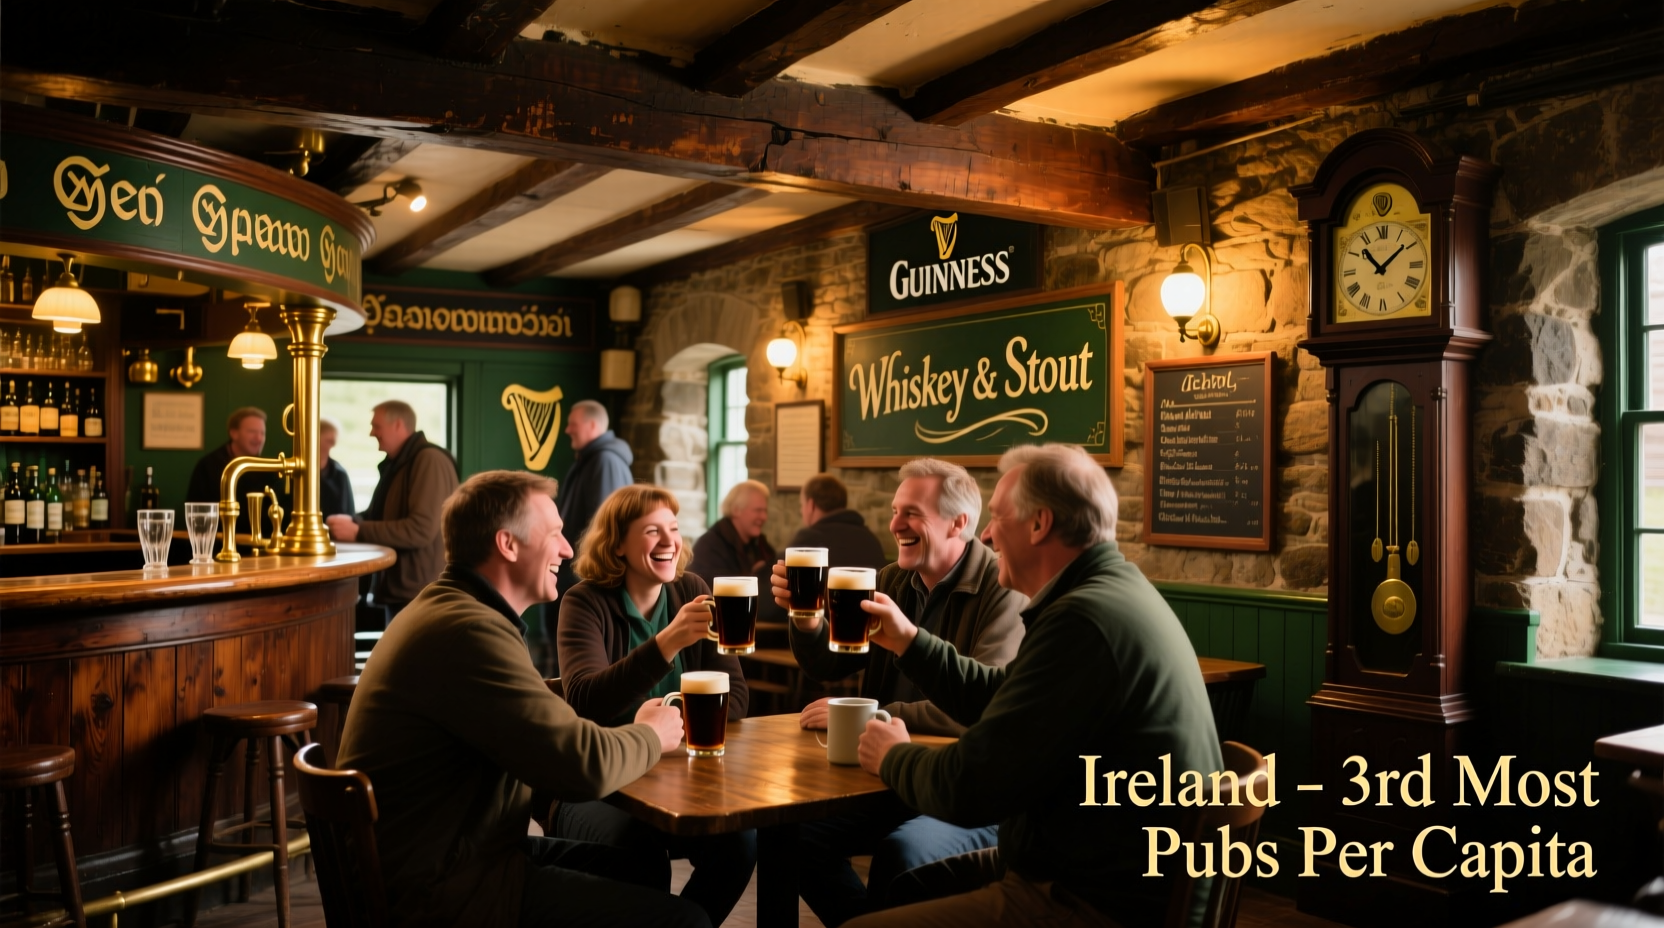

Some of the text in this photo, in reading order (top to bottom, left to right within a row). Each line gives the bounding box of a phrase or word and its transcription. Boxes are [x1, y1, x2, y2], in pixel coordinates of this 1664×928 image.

[889, 251, 1010, 300] GUINNESS
[850, 336, 1093, 423] Whiskey & Stout
